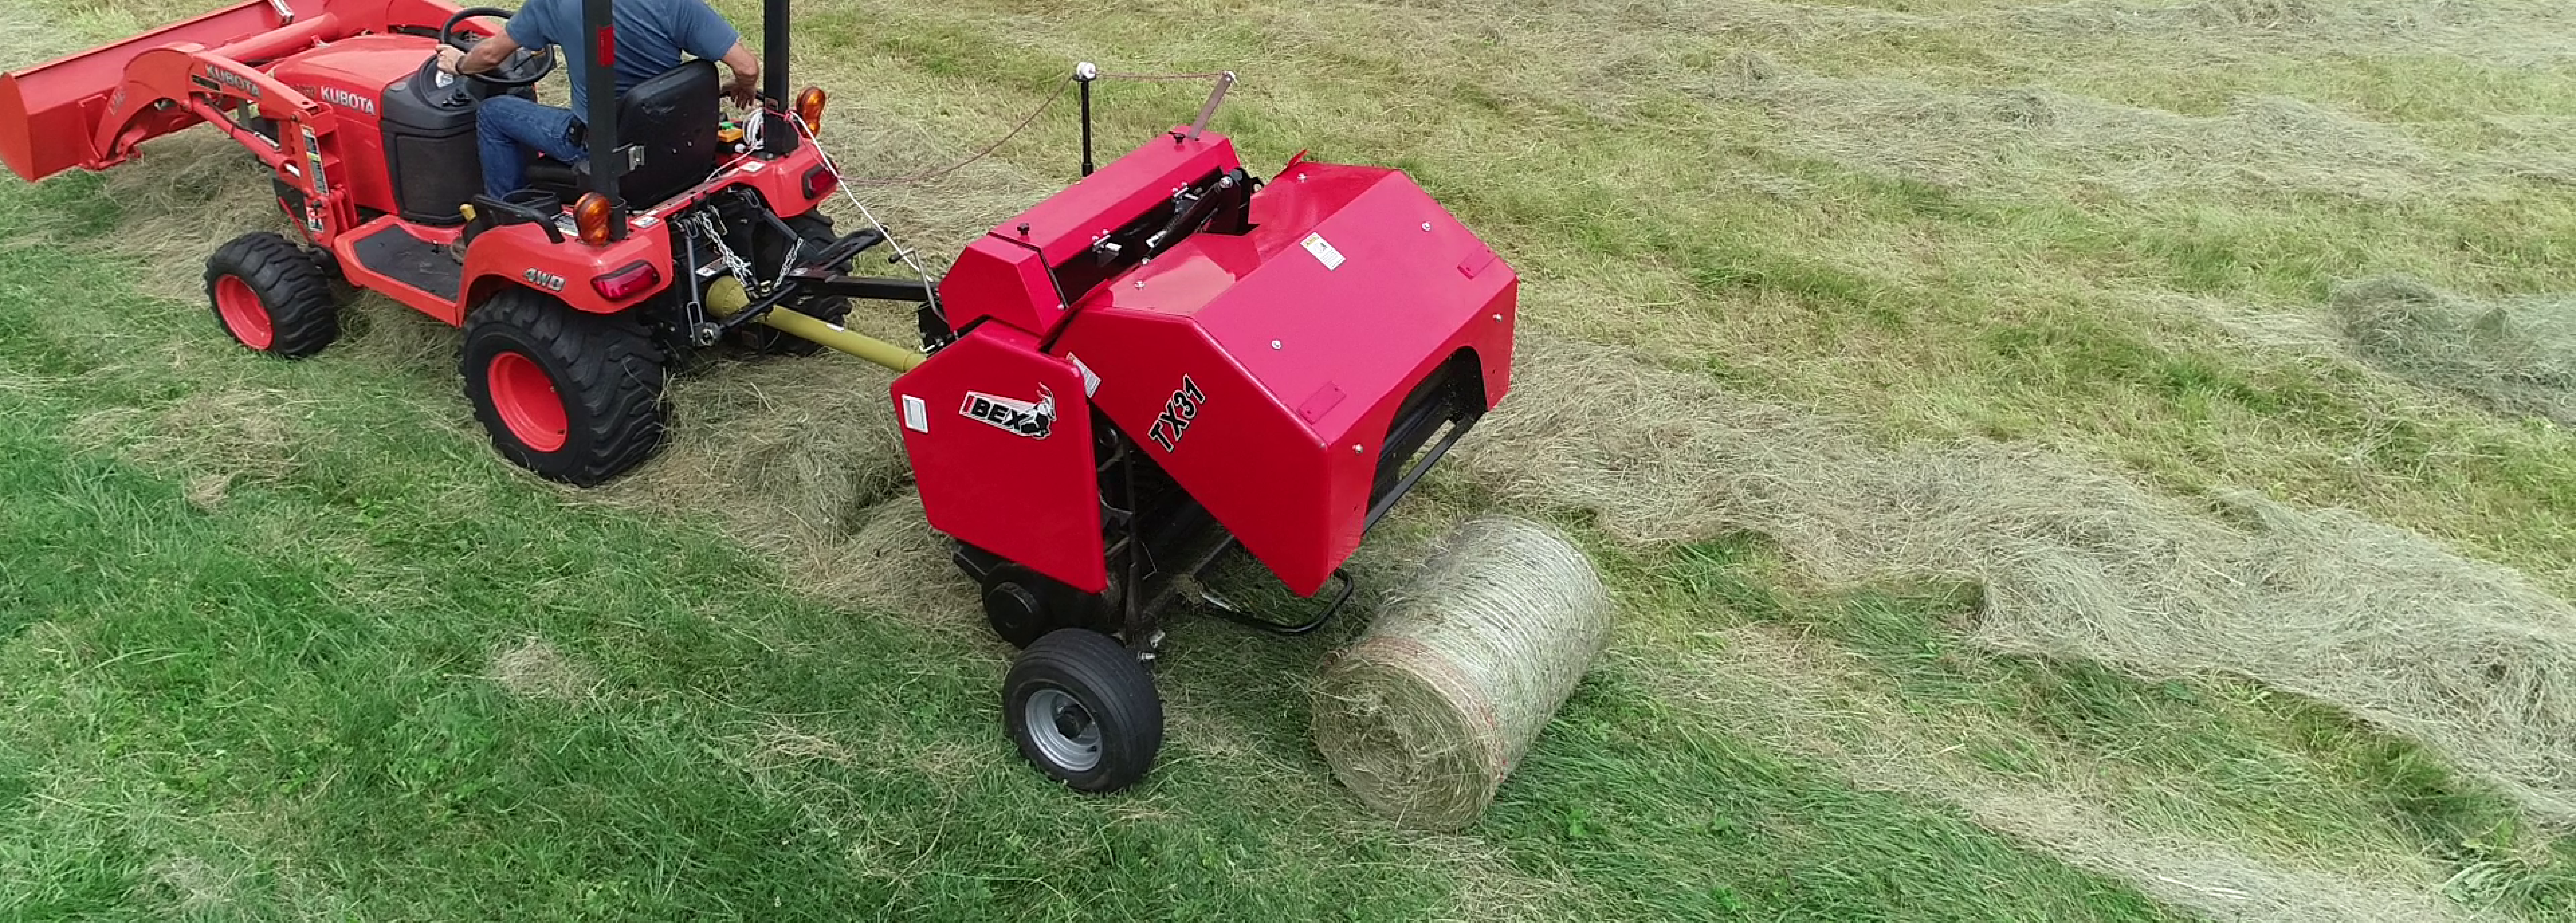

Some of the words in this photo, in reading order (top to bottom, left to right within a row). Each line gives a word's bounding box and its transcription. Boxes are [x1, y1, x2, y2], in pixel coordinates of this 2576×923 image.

[205, 64, 262, 99] KUBOTA
[320, 86, 374, 115] KUBOTA
[525, 268, 566, 291] 4WD
[961, 393, 1030, 430] IBEX
[1147, 373, 1205, 452] TX31
